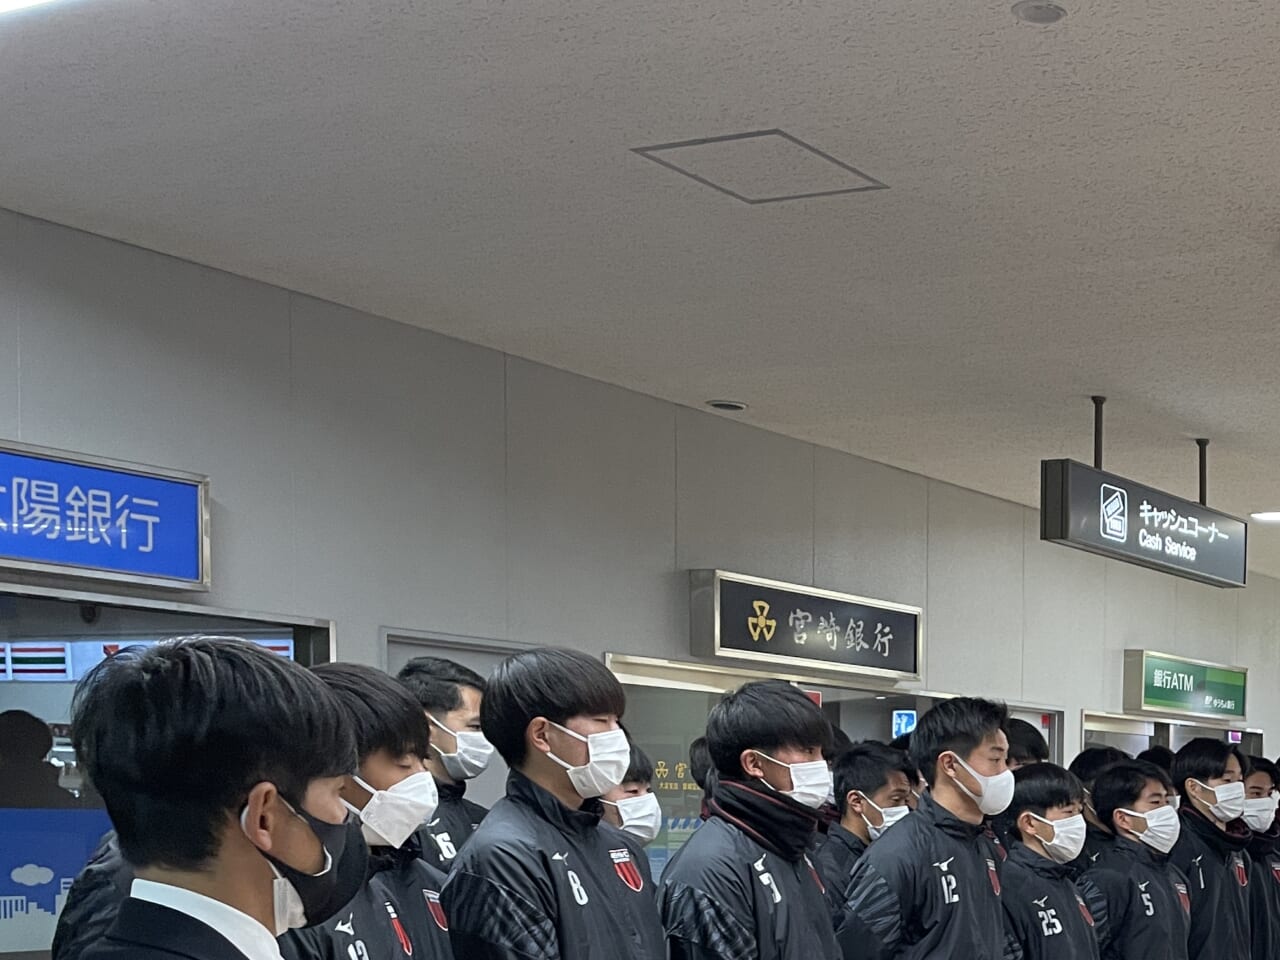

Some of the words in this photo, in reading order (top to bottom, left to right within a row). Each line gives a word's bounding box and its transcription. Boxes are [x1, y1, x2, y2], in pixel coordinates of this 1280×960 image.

[1139, 500, 1229, 543] キャッシュコーナー
[1139, 528, 1162, 551] Cash
[1164, 536, 1197, 561] Service
[789, 608, 894, 657] 宮崎銀行
[1153, 669, 1194, 692] 銀行ATM
[567, 870, 589, 906] 8
[941, 875, 960, 904] 12
[1141, 894, 1154, 916] 5
[1038, 909, 1063, 936] 25
